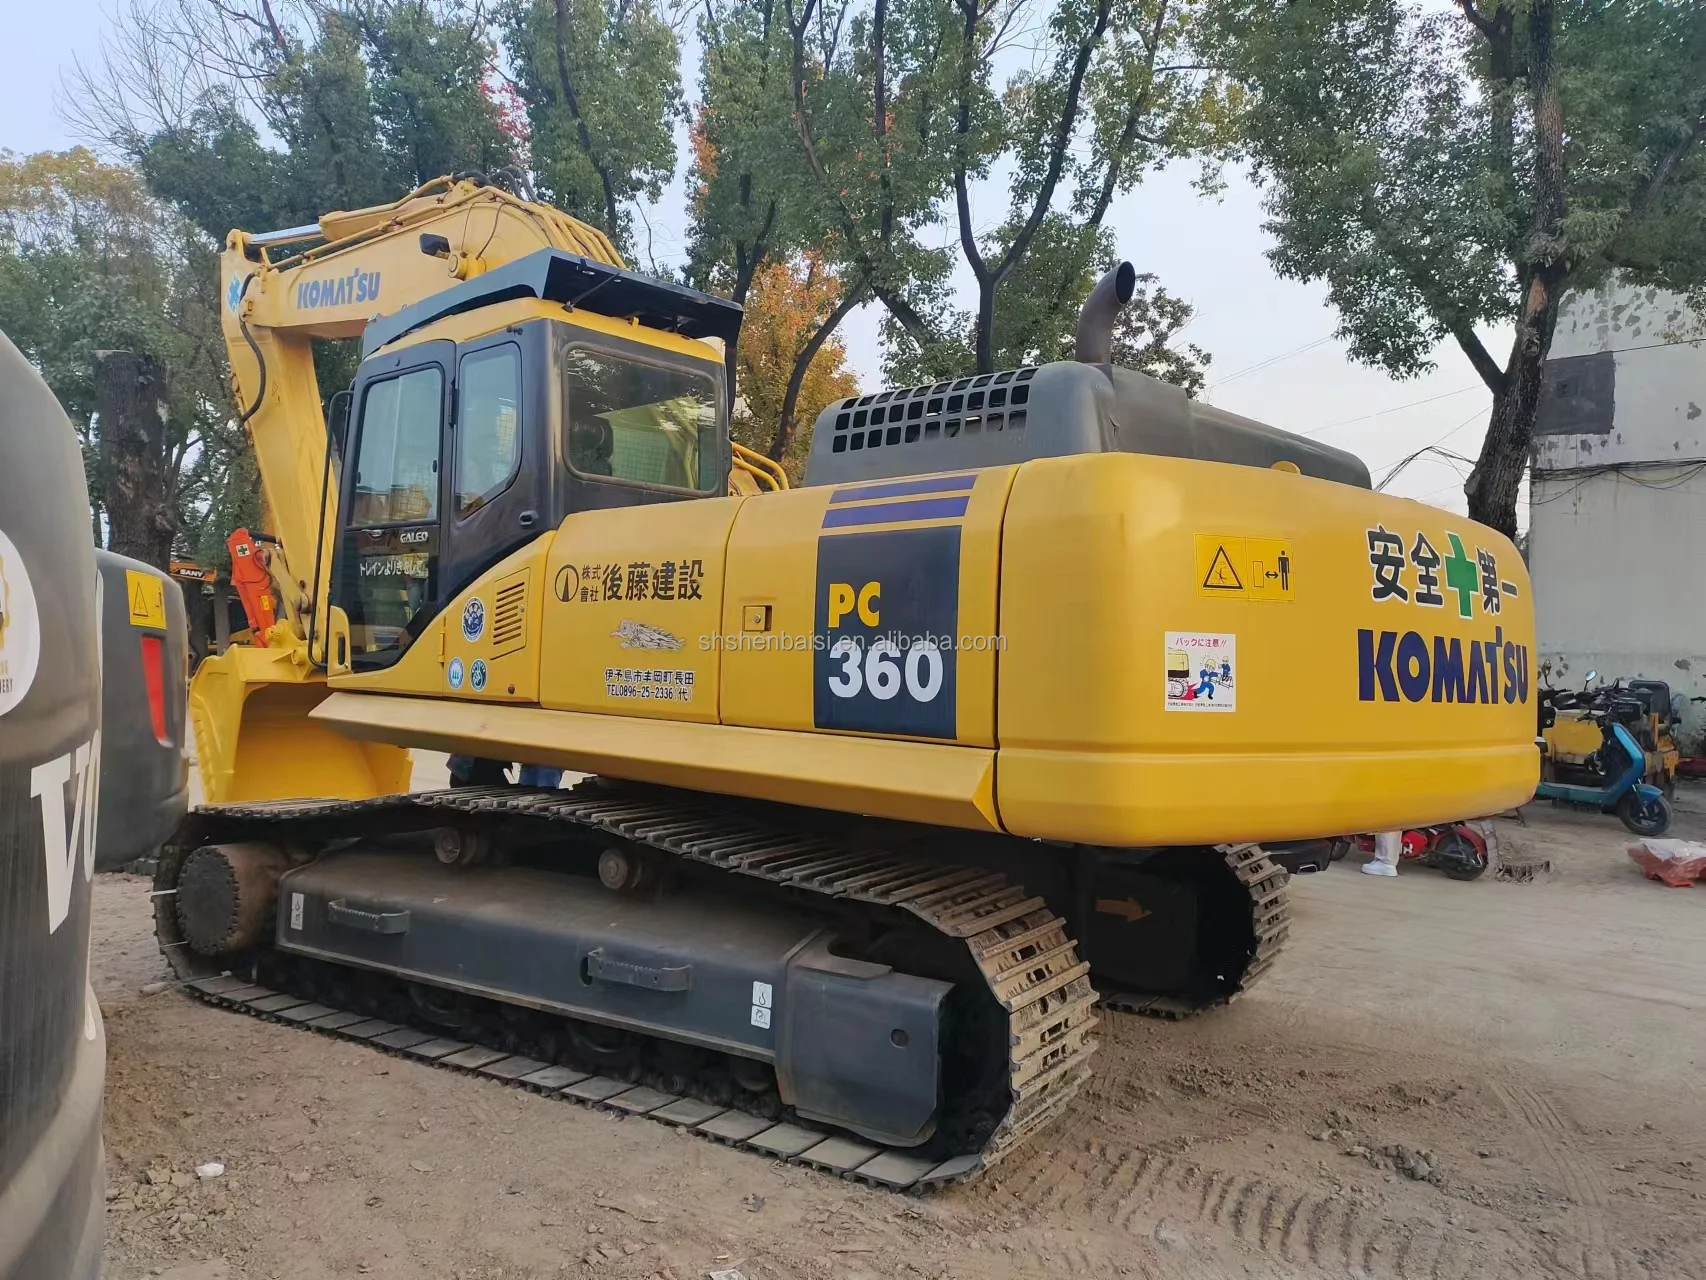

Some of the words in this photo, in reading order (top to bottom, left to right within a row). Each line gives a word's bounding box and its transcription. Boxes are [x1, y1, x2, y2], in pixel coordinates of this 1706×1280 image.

[296, 267, 381, 310] KOMATSU
[400, 531, 429, 544] GALEO
[180, 568, 203, 578] SANY
[828, 581, 881, 628] PC
[0, 677, 13, 694] ERY
[828, 639, 943, 702] 360
[1357, 625, 1529, 705] KOMATSU
